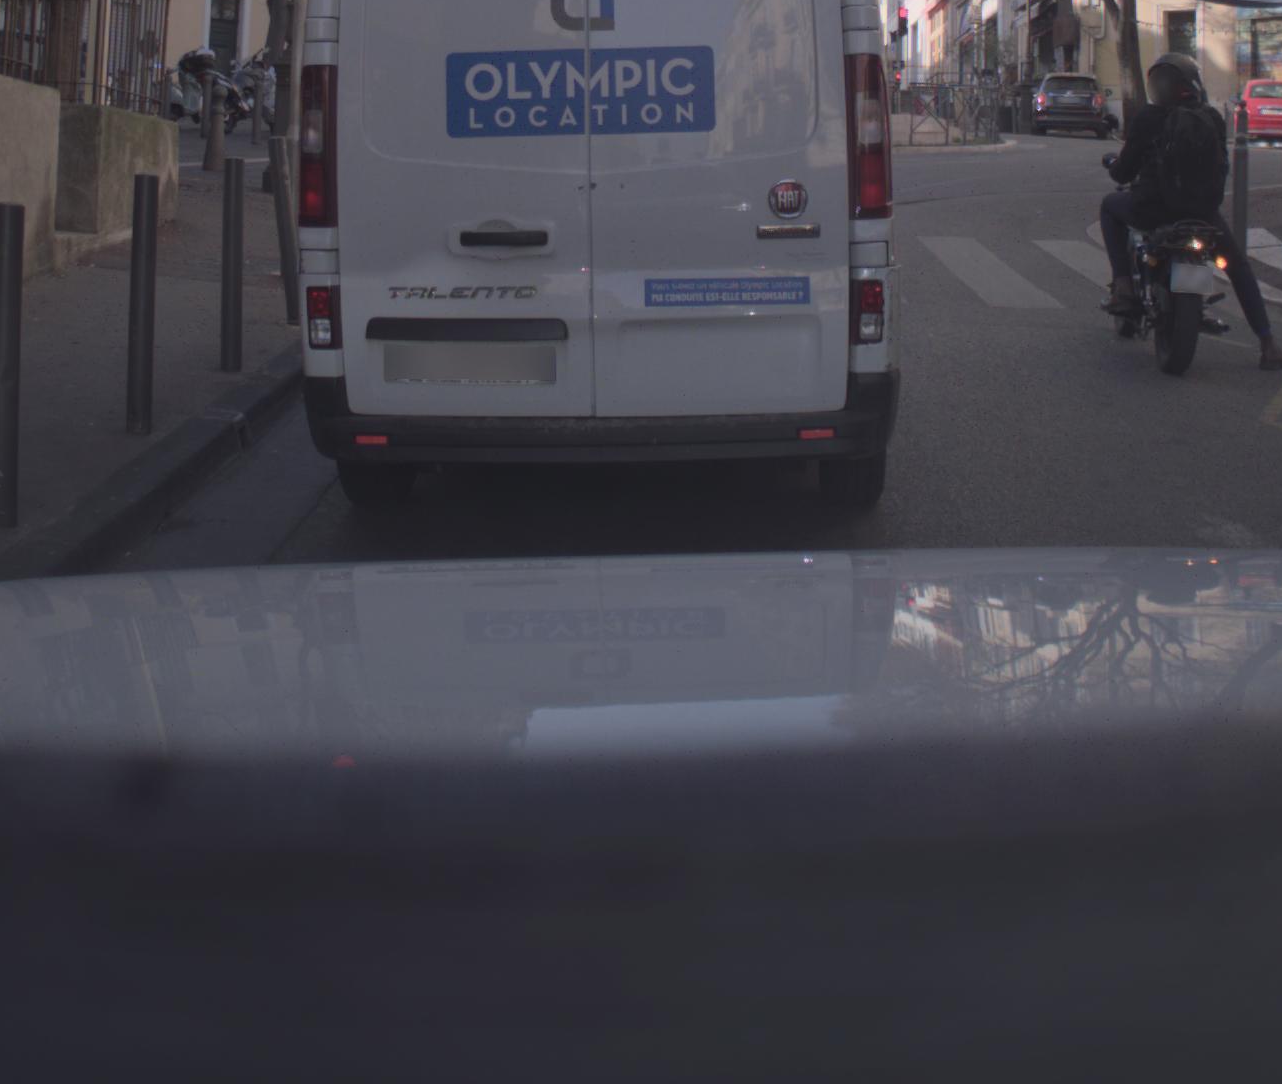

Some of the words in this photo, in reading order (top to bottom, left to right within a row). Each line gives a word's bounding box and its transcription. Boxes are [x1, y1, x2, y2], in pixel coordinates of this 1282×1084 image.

[464, 57, 696, 101] OLYMPIC
[469, 102, 695, 130] LOCATION
[777, 189, 800, 210] FIAT
[388, 284, 538, 300] TALENTO
